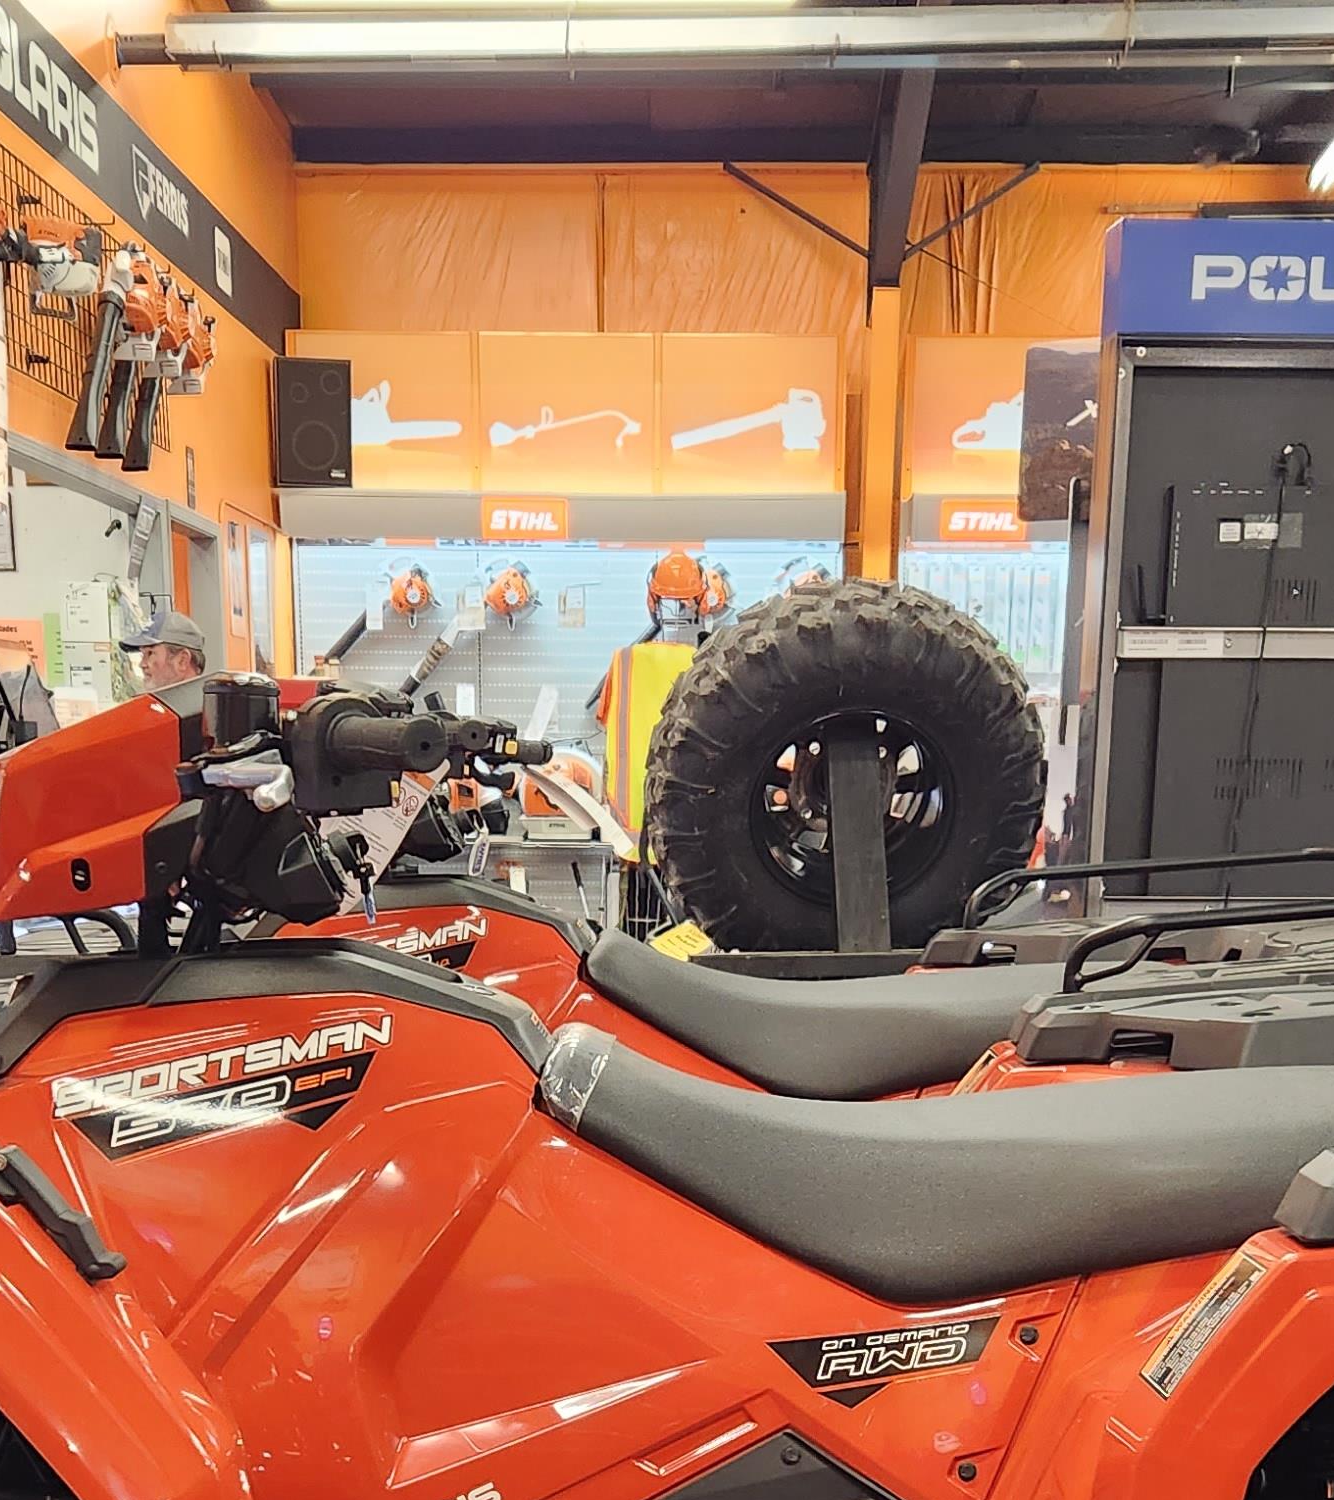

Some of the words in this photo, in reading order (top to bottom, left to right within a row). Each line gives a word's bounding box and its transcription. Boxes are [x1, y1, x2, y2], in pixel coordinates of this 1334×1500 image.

[148, 166, 189, 239] FERRIS
[490, 509, 559, 531] STIHL
[948, 511, 1019, 532] STIHL
[51, 1013, 394, 1119] SPORTSMAN
[294, 1066, 353, 1092] EFI
[822, 1337, 856, 1351] ON
[866, 1323, 970, 1346] DEMAND
[816, 1336, 967, 1380] AWD
